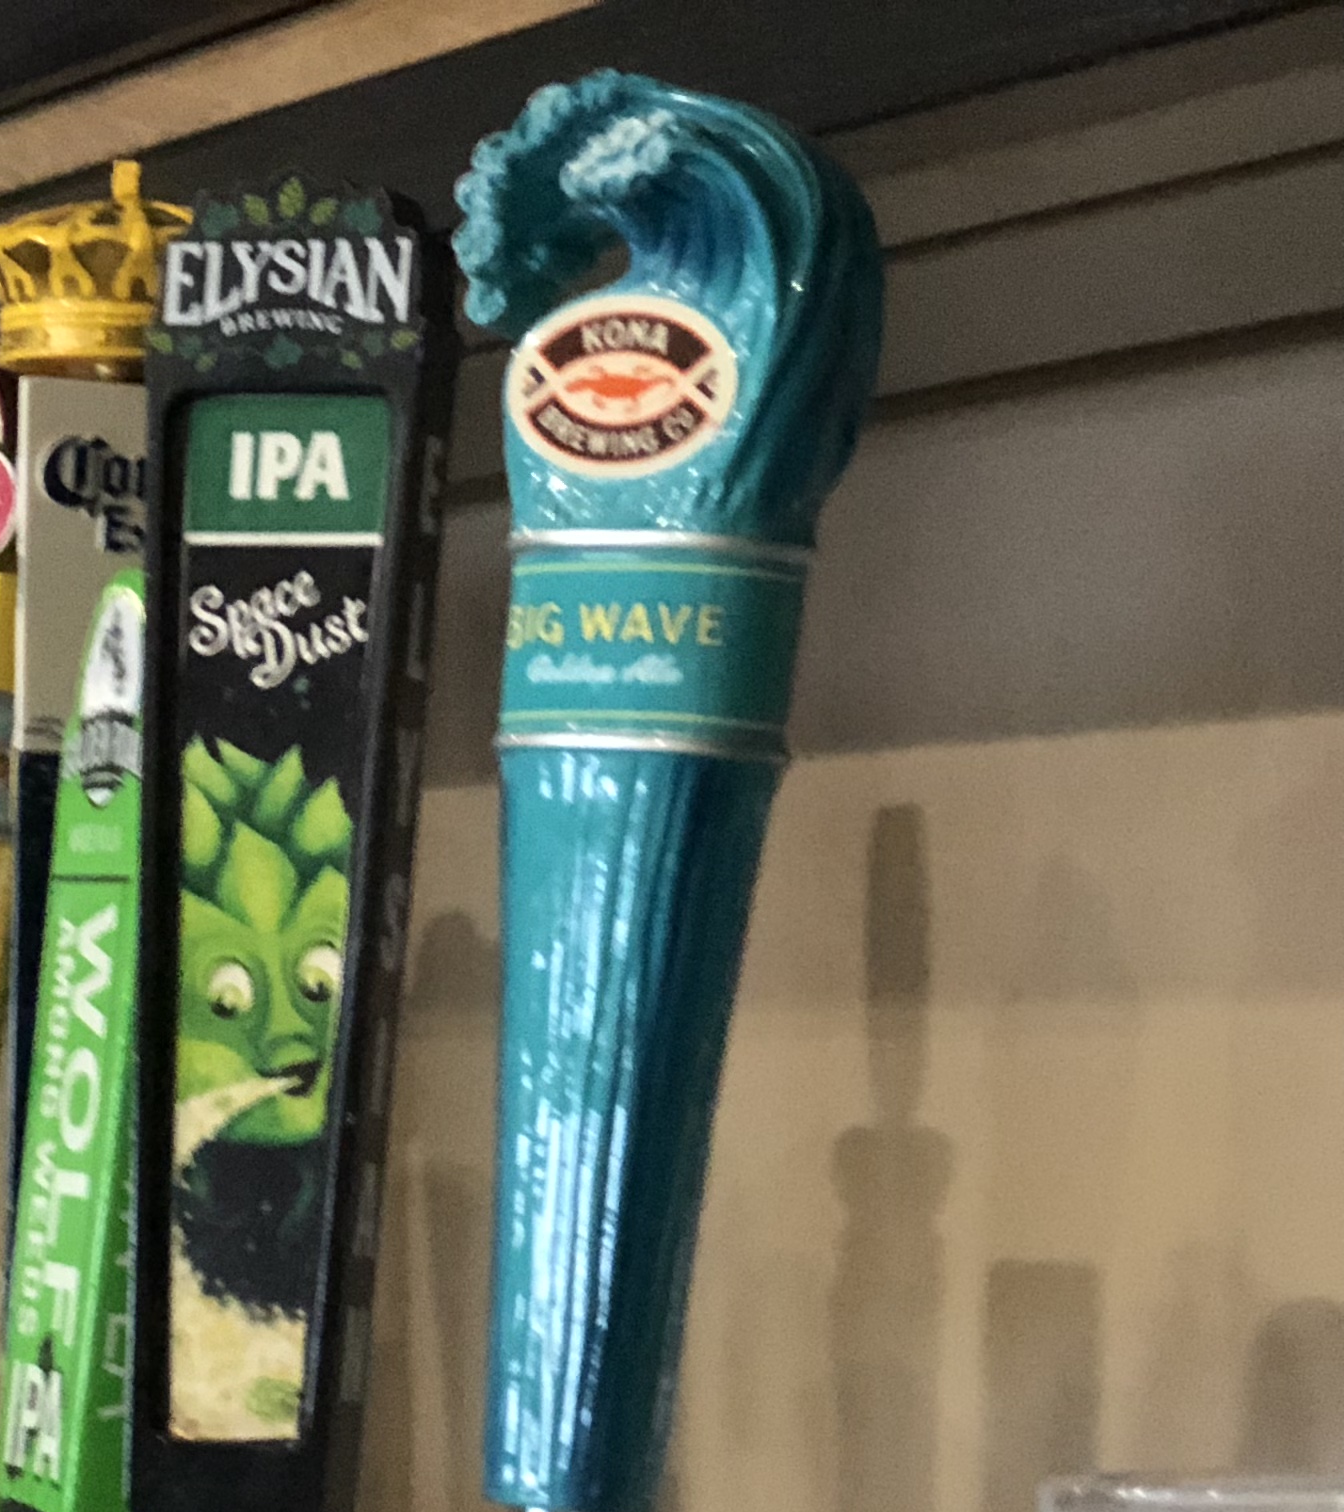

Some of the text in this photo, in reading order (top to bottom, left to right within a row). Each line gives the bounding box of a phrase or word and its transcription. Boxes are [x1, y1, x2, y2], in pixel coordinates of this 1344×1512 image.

[163, 236, 413, 326] ELYSIAN
[580, 318, 669, 355] KONA
[229, 431, 350, 500] IPA
[189, 570, 322, 661] Space
[248, 595, 370, 691] Dust
[506, 601, 726, 650] BIG WAVE
[45, 903, 120, 1348] WOLF
